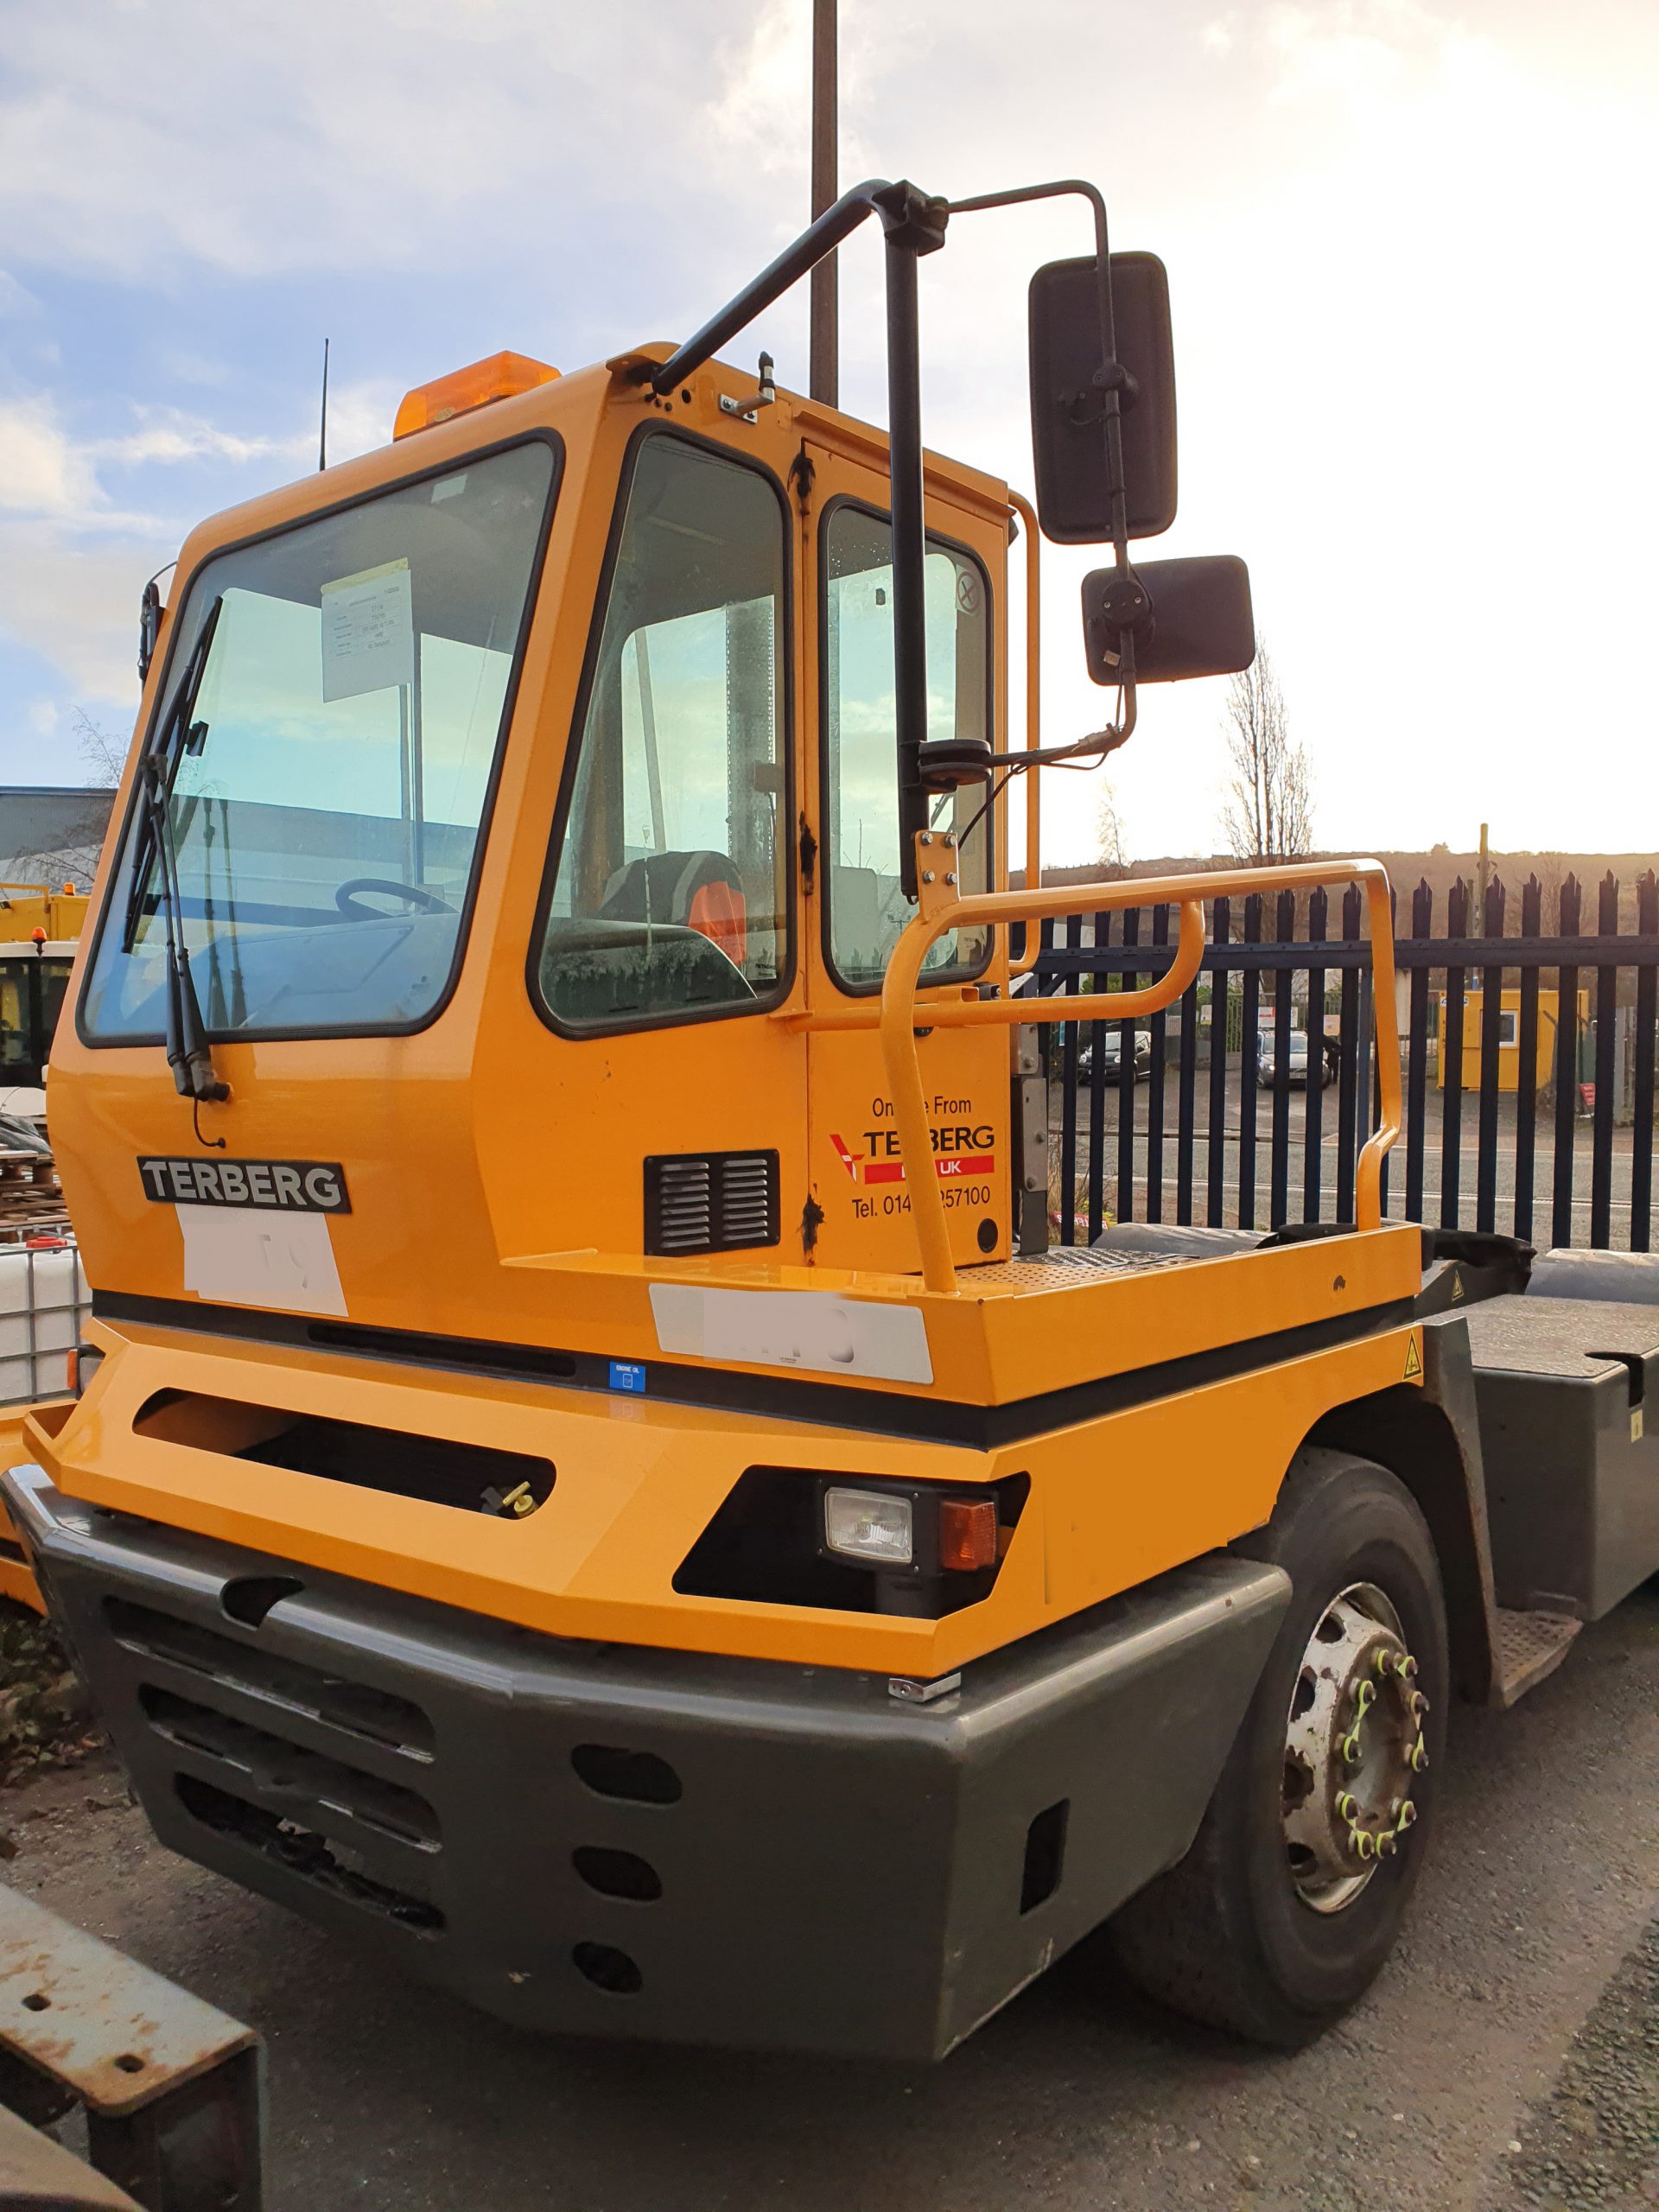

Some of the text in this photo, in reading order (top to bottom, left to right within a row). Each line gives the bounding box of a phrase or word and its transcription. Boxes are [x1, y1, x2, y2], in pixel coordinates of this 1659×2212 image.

[872, 1097, 893, 1117] On
[934, 1095, 971, 1115] From
[863, 1126, 995, 1157] TEBERG
[940, 1160, 961, 1175] UK
[143, 1160, 341, 1207] TERBERG
[852, 1197, 878, 1218] Tel.
